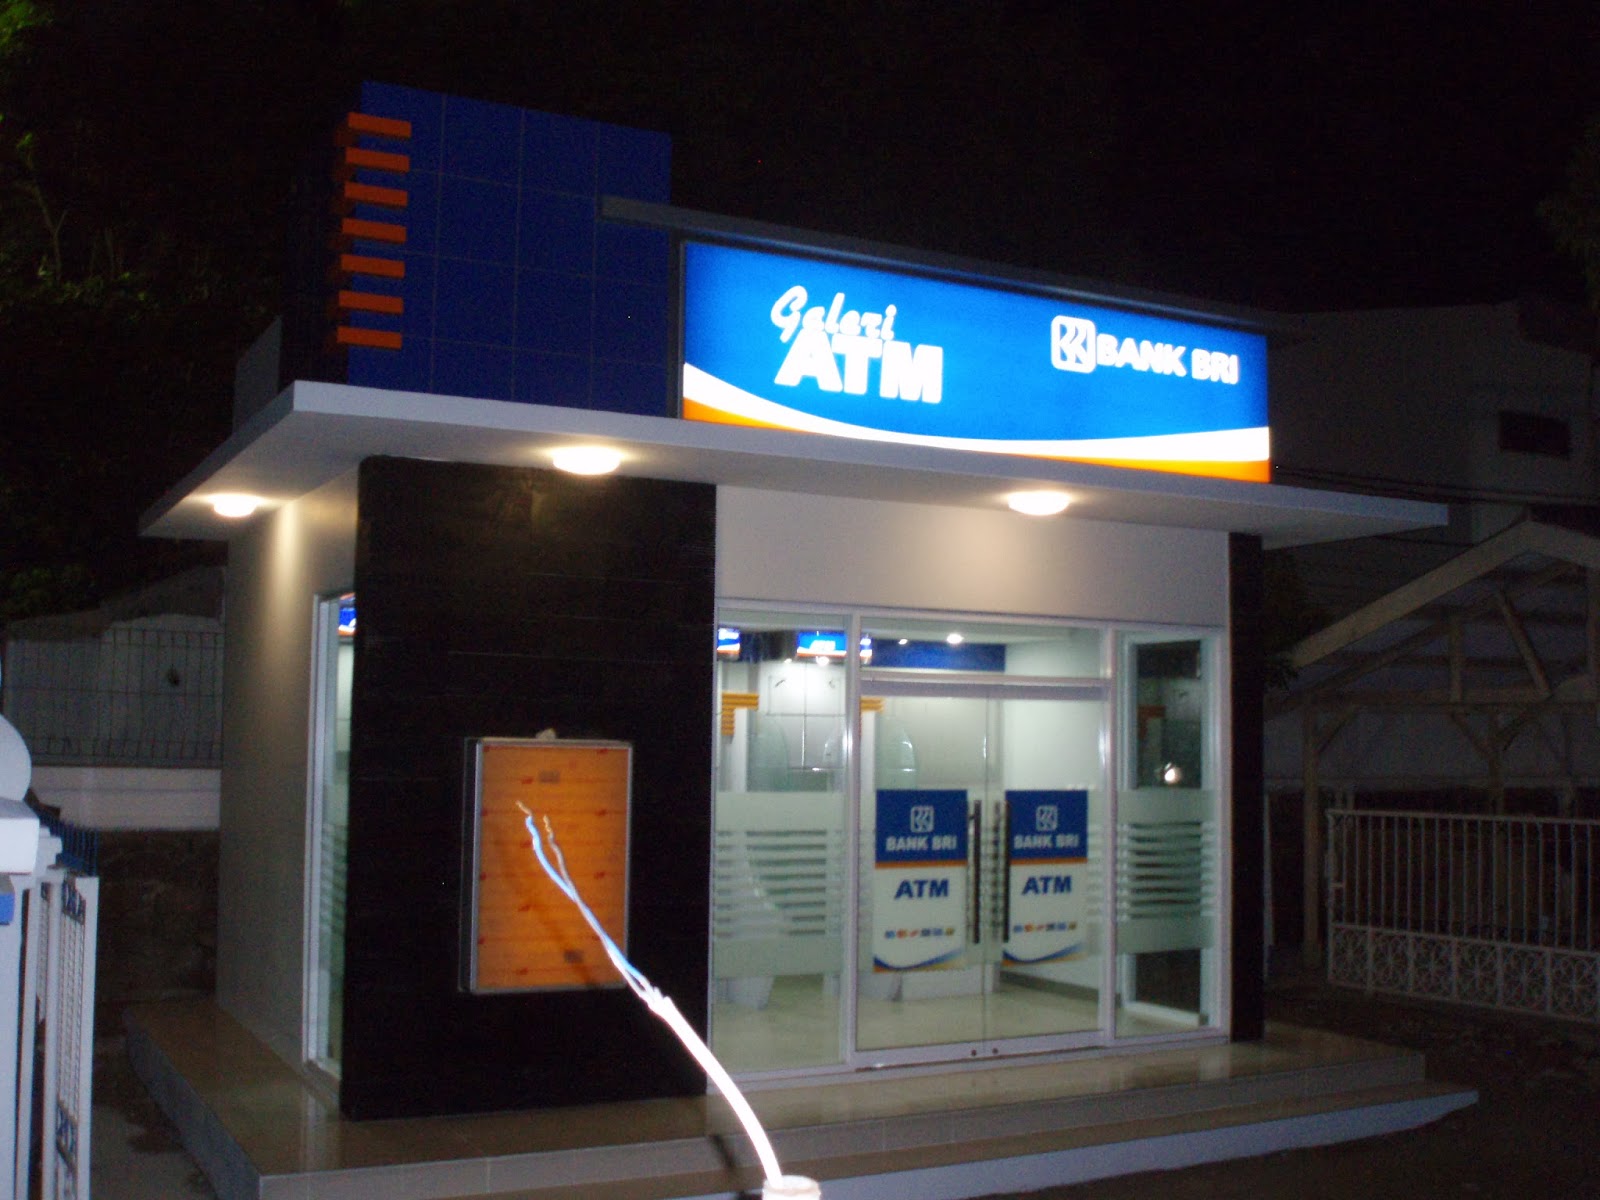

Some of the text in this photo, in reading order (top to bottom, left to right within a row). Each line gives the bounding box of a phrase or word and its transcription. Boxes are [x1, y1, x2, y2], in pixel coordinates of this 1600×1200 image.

[774, 328, 944, 404] ATM
[1097, 333, 1239, 385] BANK BRI
[886, 836, 957, 851] BANK BRI
[1014, 834, 1079, 849] BANK BRI
[894, 879, 949, 900] ATM
[1022, 875, 1072, 895] ATM
